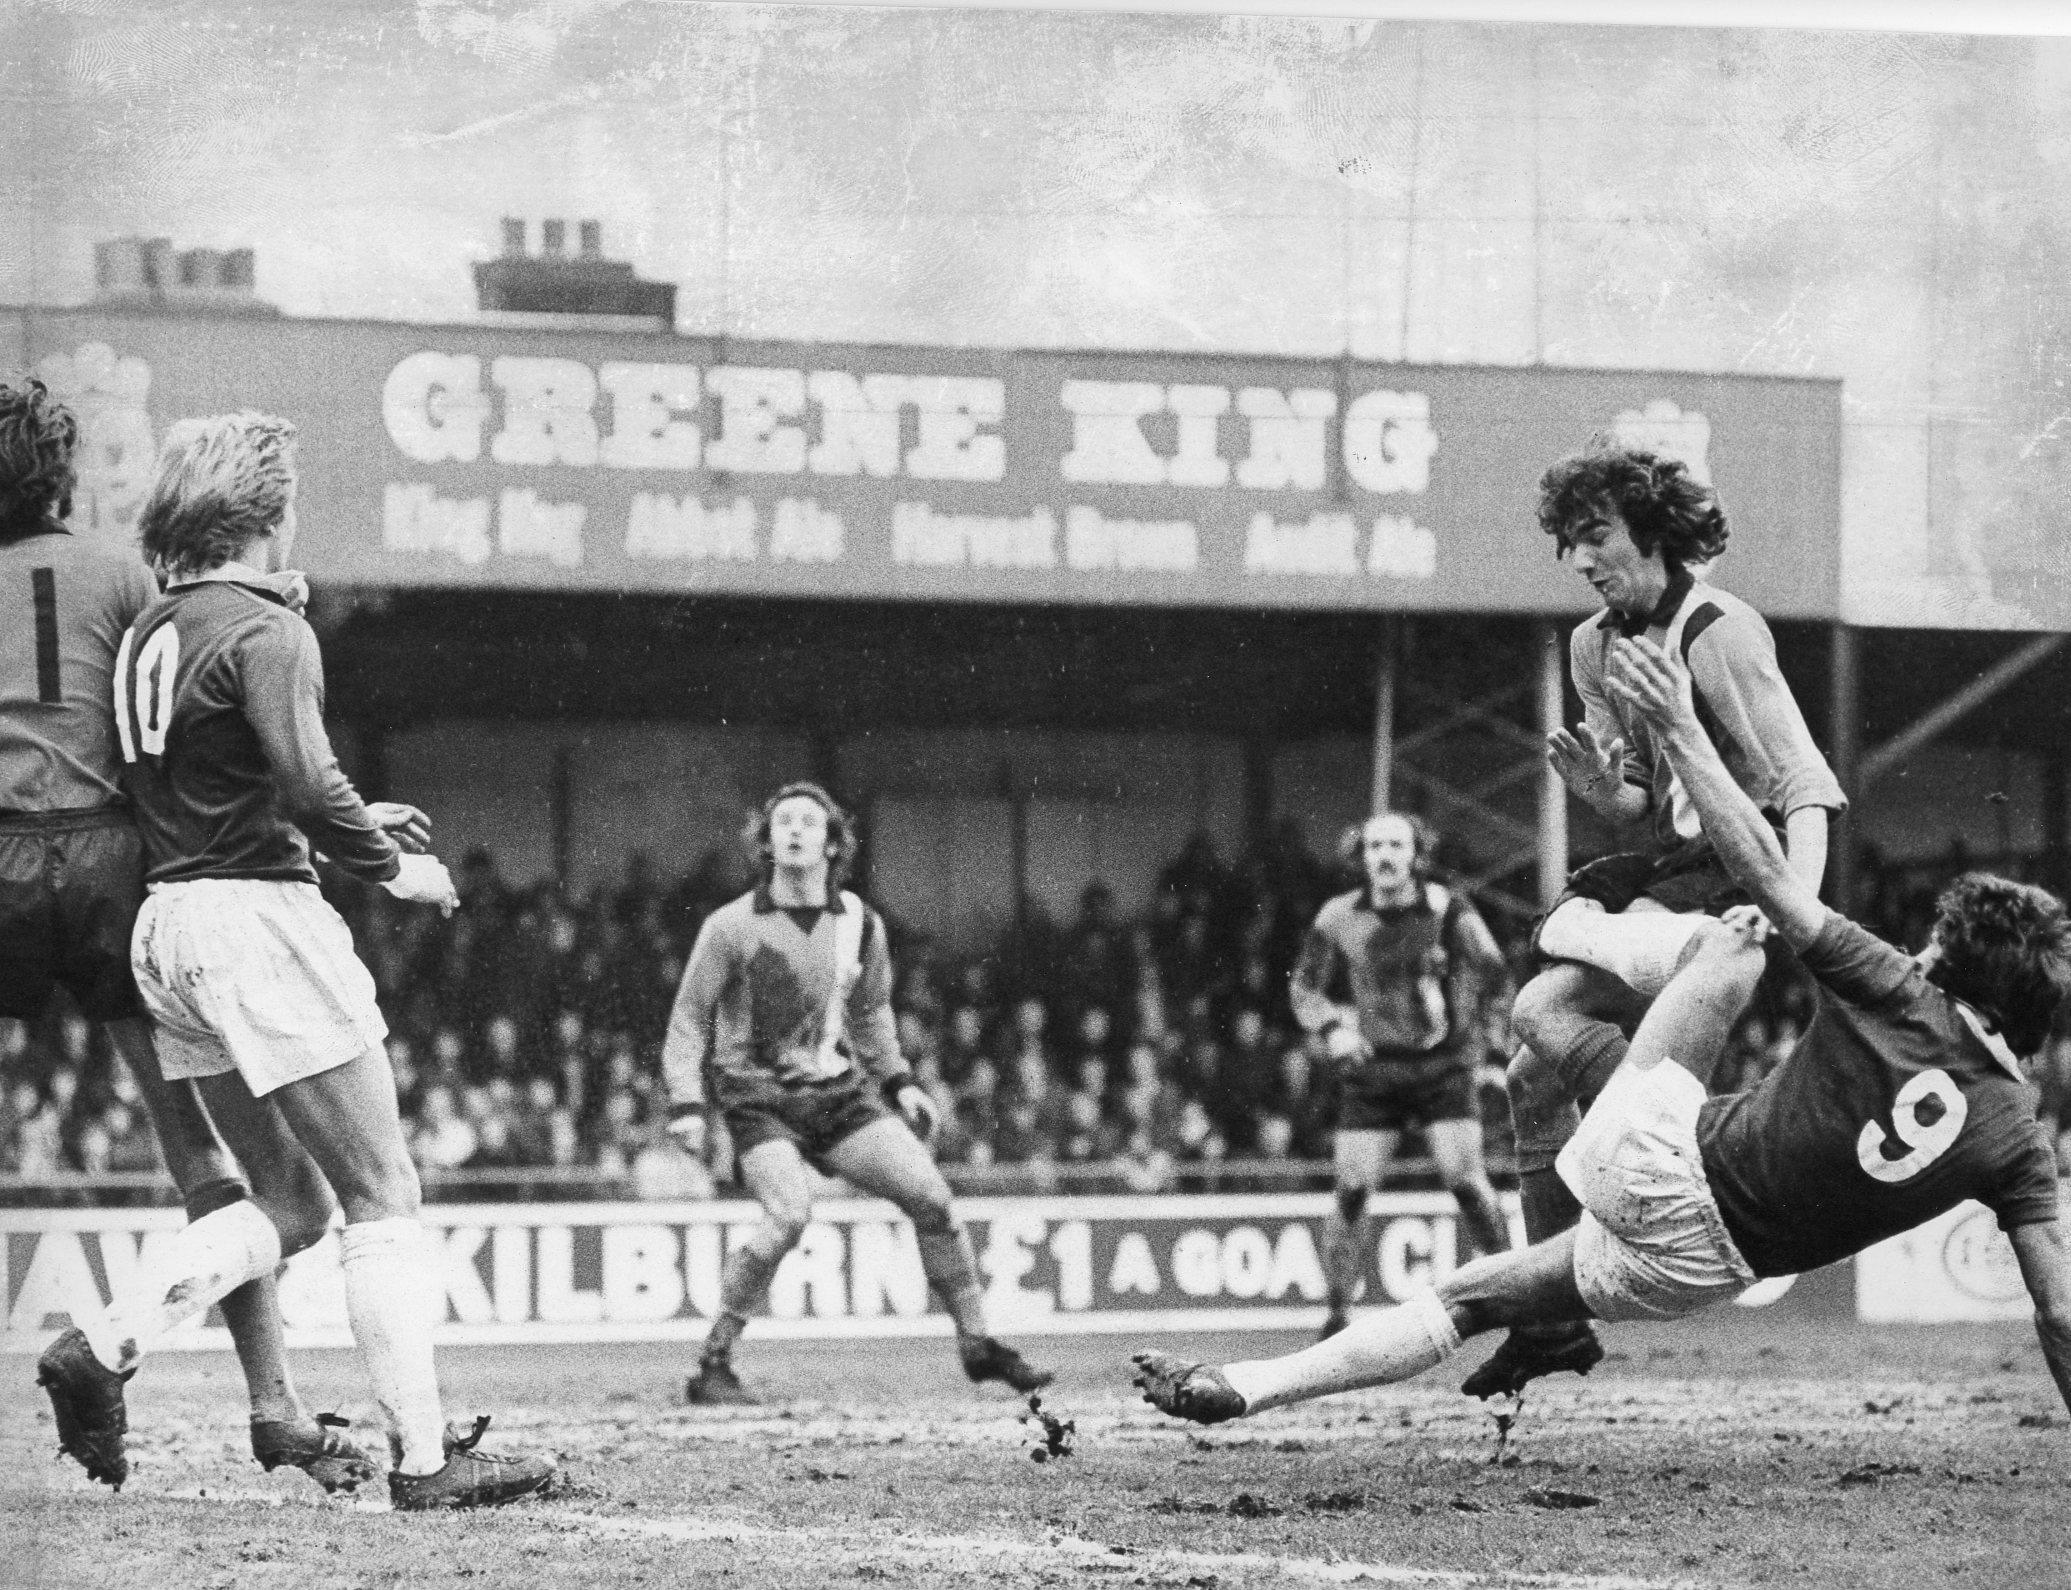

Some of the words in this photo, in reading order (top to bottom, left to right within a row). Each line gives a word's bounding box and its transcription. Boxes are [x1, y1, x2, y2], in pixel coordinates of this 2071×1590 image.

[382, 351, 1006, 481] GREENE
[1060, 379, 1438, 495] KING
[113, 621, 180, 763] 10
[1857, 1069, 1968, 1184] 9
[1108, 1231, 1161, 1295] A
[1171, 1221, 1367, 1301] GOA
